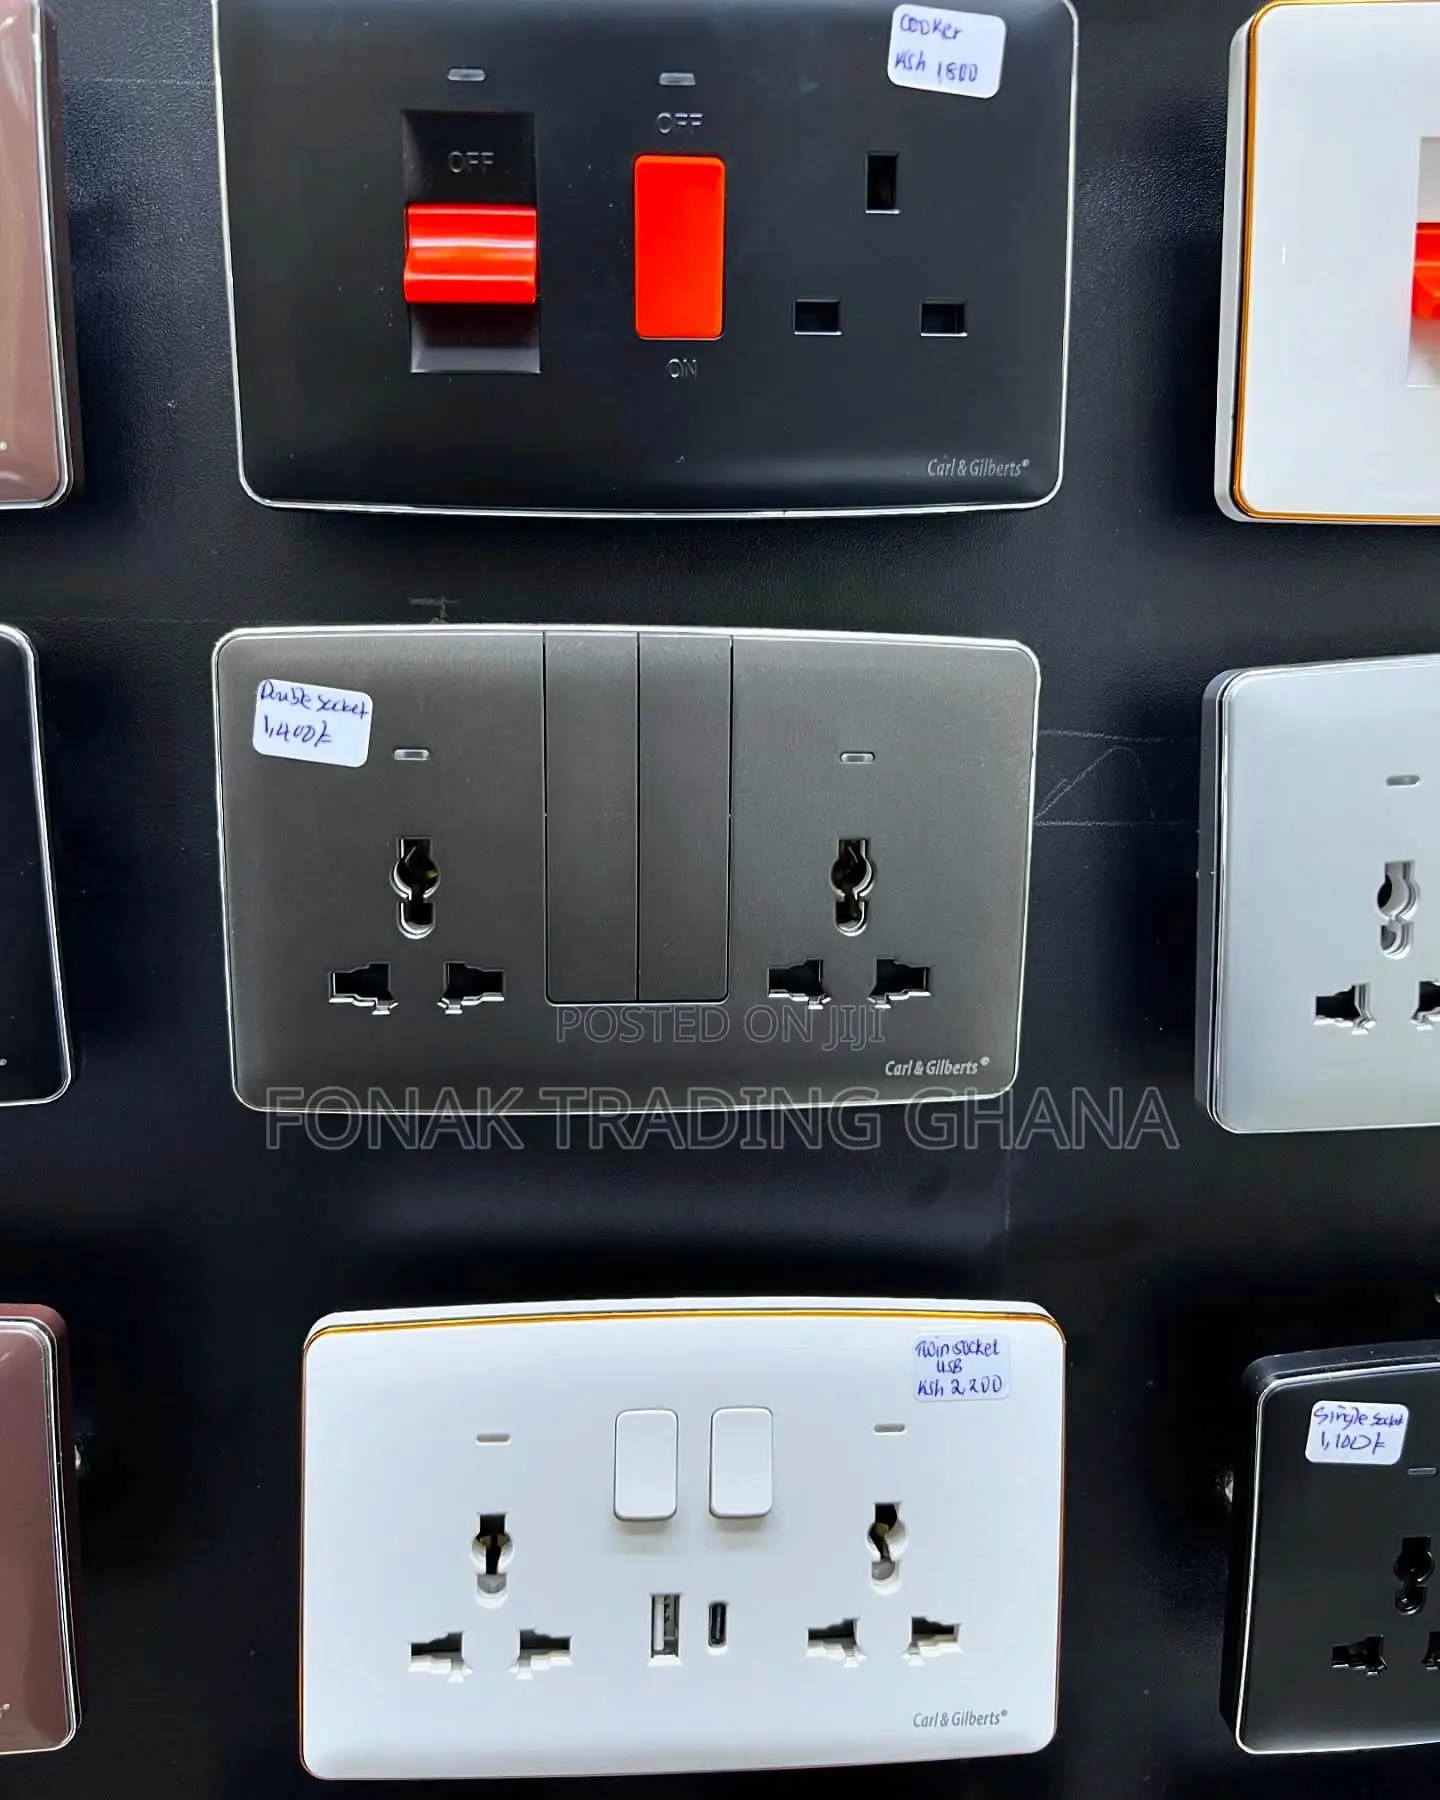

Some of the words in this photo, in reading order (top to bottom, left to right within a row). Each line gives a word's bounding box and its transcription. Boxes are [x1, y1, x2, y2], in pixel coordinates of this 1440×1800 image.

[937, 61, 978, 83] 1800
[656, 112, 703, 134] OFF
[448, 150, 494, 173] OFF
[666, 357, 697, 379] ON
[927, 458, 956, 477] Carl
[957, 459, 967, 477] &
[885, 1059, 913, 1077] Carl
[914, 1060, 925, 1076] &
[912, 1710, 939, 1728] Carl
[940, 1711, 949, 1728] &
